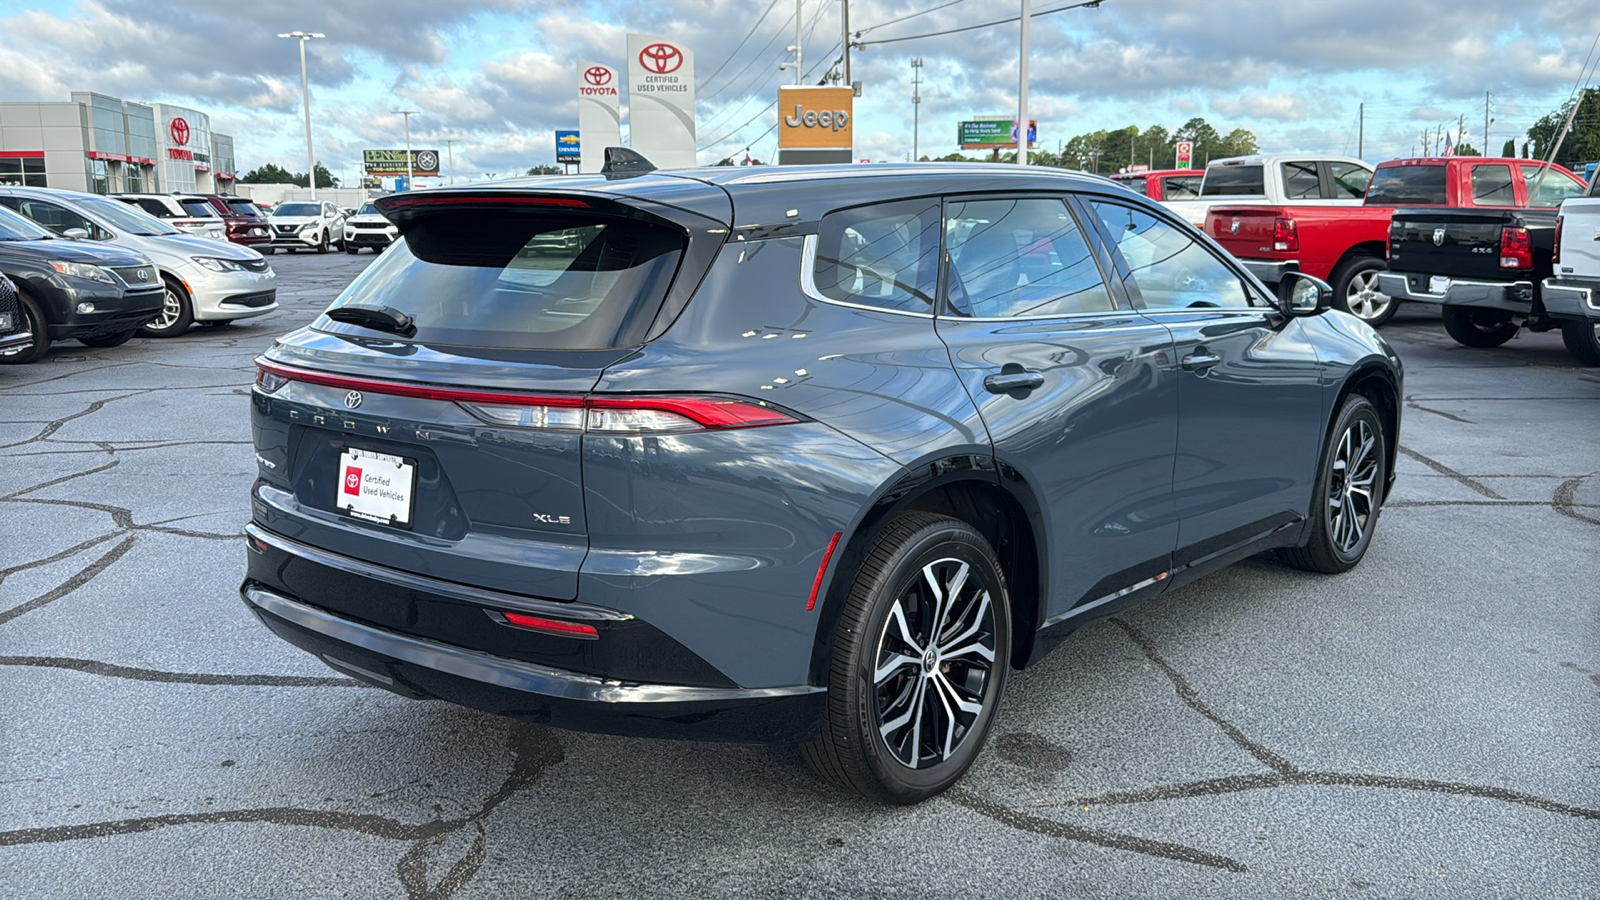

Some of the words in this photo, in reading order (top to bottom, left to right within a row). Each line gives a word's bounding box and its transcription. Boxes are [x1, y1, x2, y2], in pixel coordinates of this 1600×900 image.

[579, 87, 618, 96] TOYOTA
[637, 84, 655, 92] USED
[656, 84, 688, 92] VEHICLES
[785, 104, 849, 132] Jeep
[168, 148, 194, 161] TOYOTA
[365, 150, 395, 161] PENN
[289, 410, 430, 441] CROWN
[364, 474, 391, 486] Certified
[363, 485, 378, 496] Used
[379, 488, 404, 502] Vehicles
[533, 513, 571, 524] XLE
